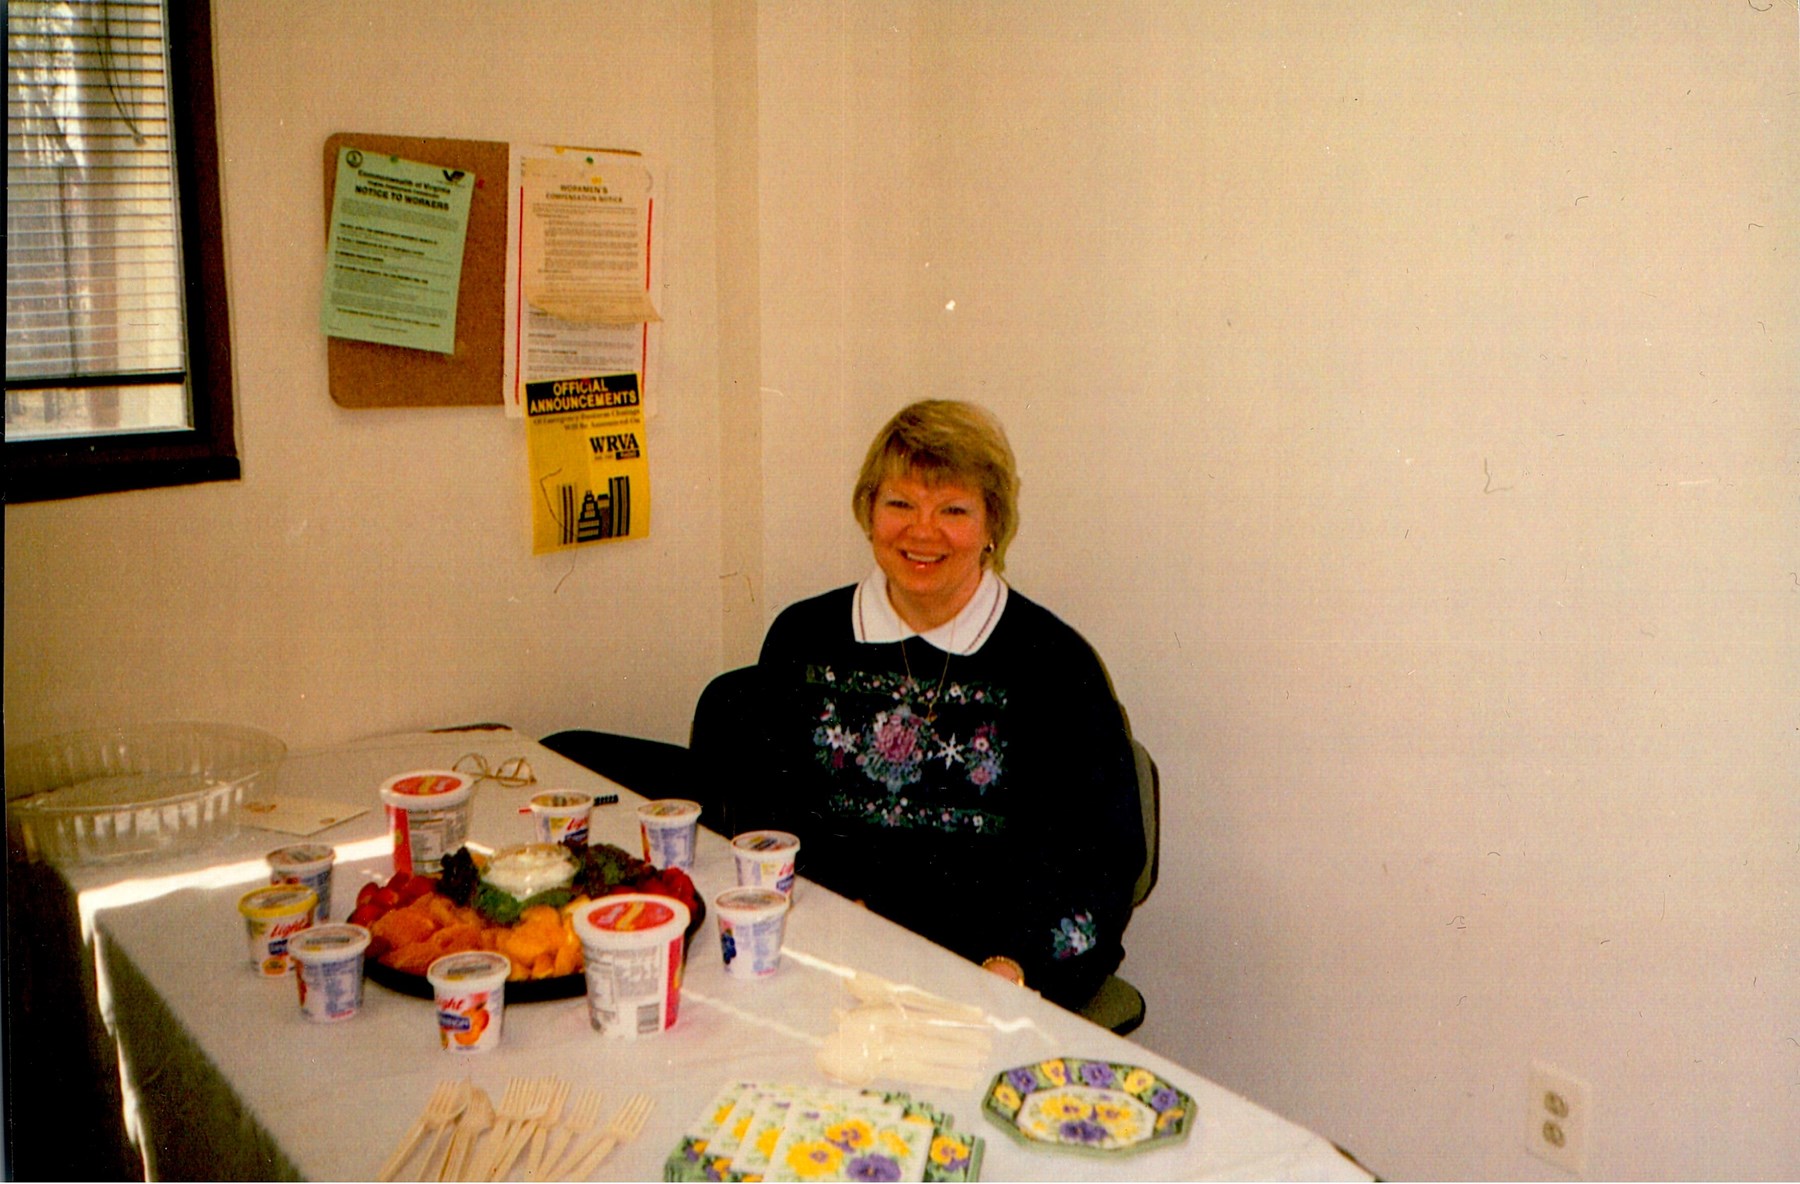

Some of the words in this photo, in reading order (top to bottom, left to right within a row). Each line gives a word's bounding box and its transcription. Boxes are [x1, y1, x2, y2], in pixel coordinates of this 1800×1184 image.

[355, 185, 389, 200] NOTICE
[391, 191, 403, 202] TO
[404, 194, 450, 211] WORKERS
[553, 378, 609, 397] OFFICIAL
[530, 389, 638, 415] ANNOUNCEMENTS
[589, 432, 639, 454] WRVA
